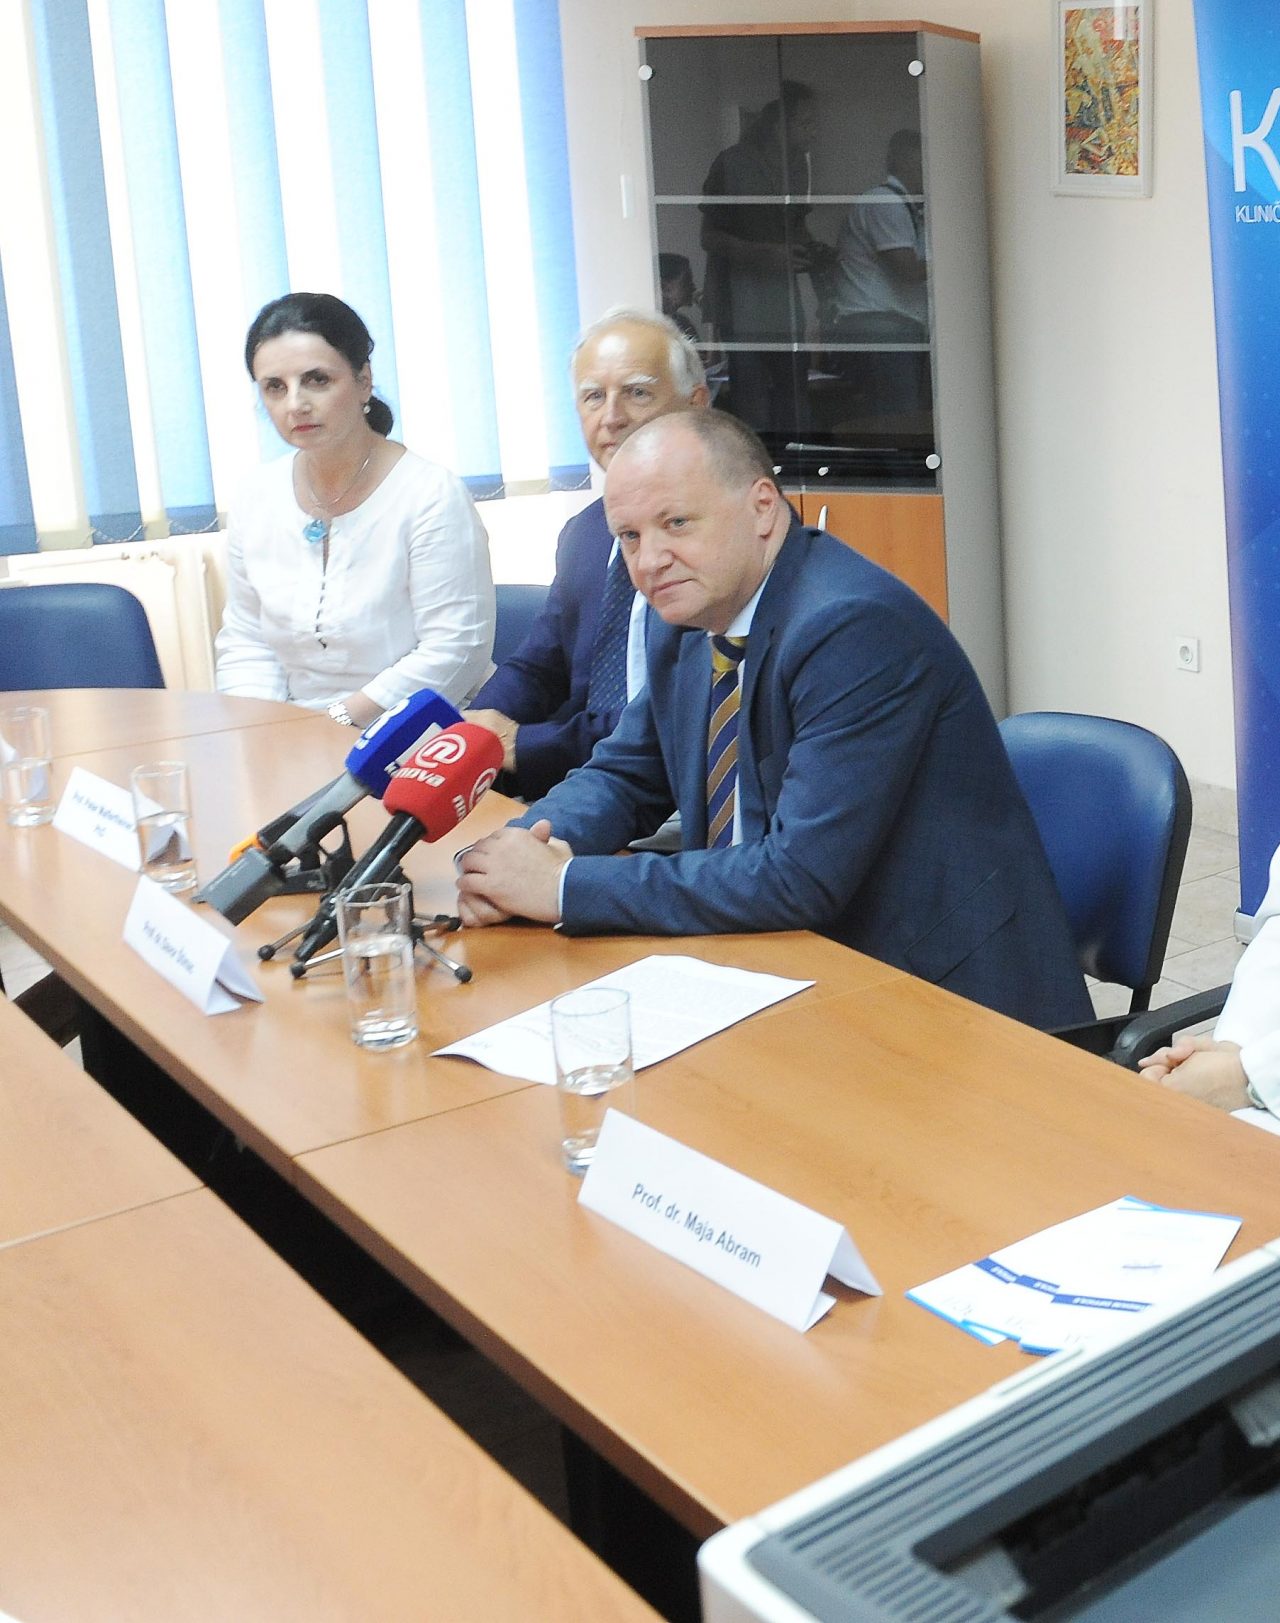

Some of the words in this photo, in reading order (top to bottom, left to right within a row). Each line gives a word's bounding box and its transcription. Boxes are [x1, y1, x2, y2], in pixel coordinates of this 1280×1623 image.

[632, 1183, 663, 1213] Prof.
[665, 1203, 681, 1224] dr.
[684, 1211, 714, 1242] Maja
[715, 1230, 761, 1268] Abram
